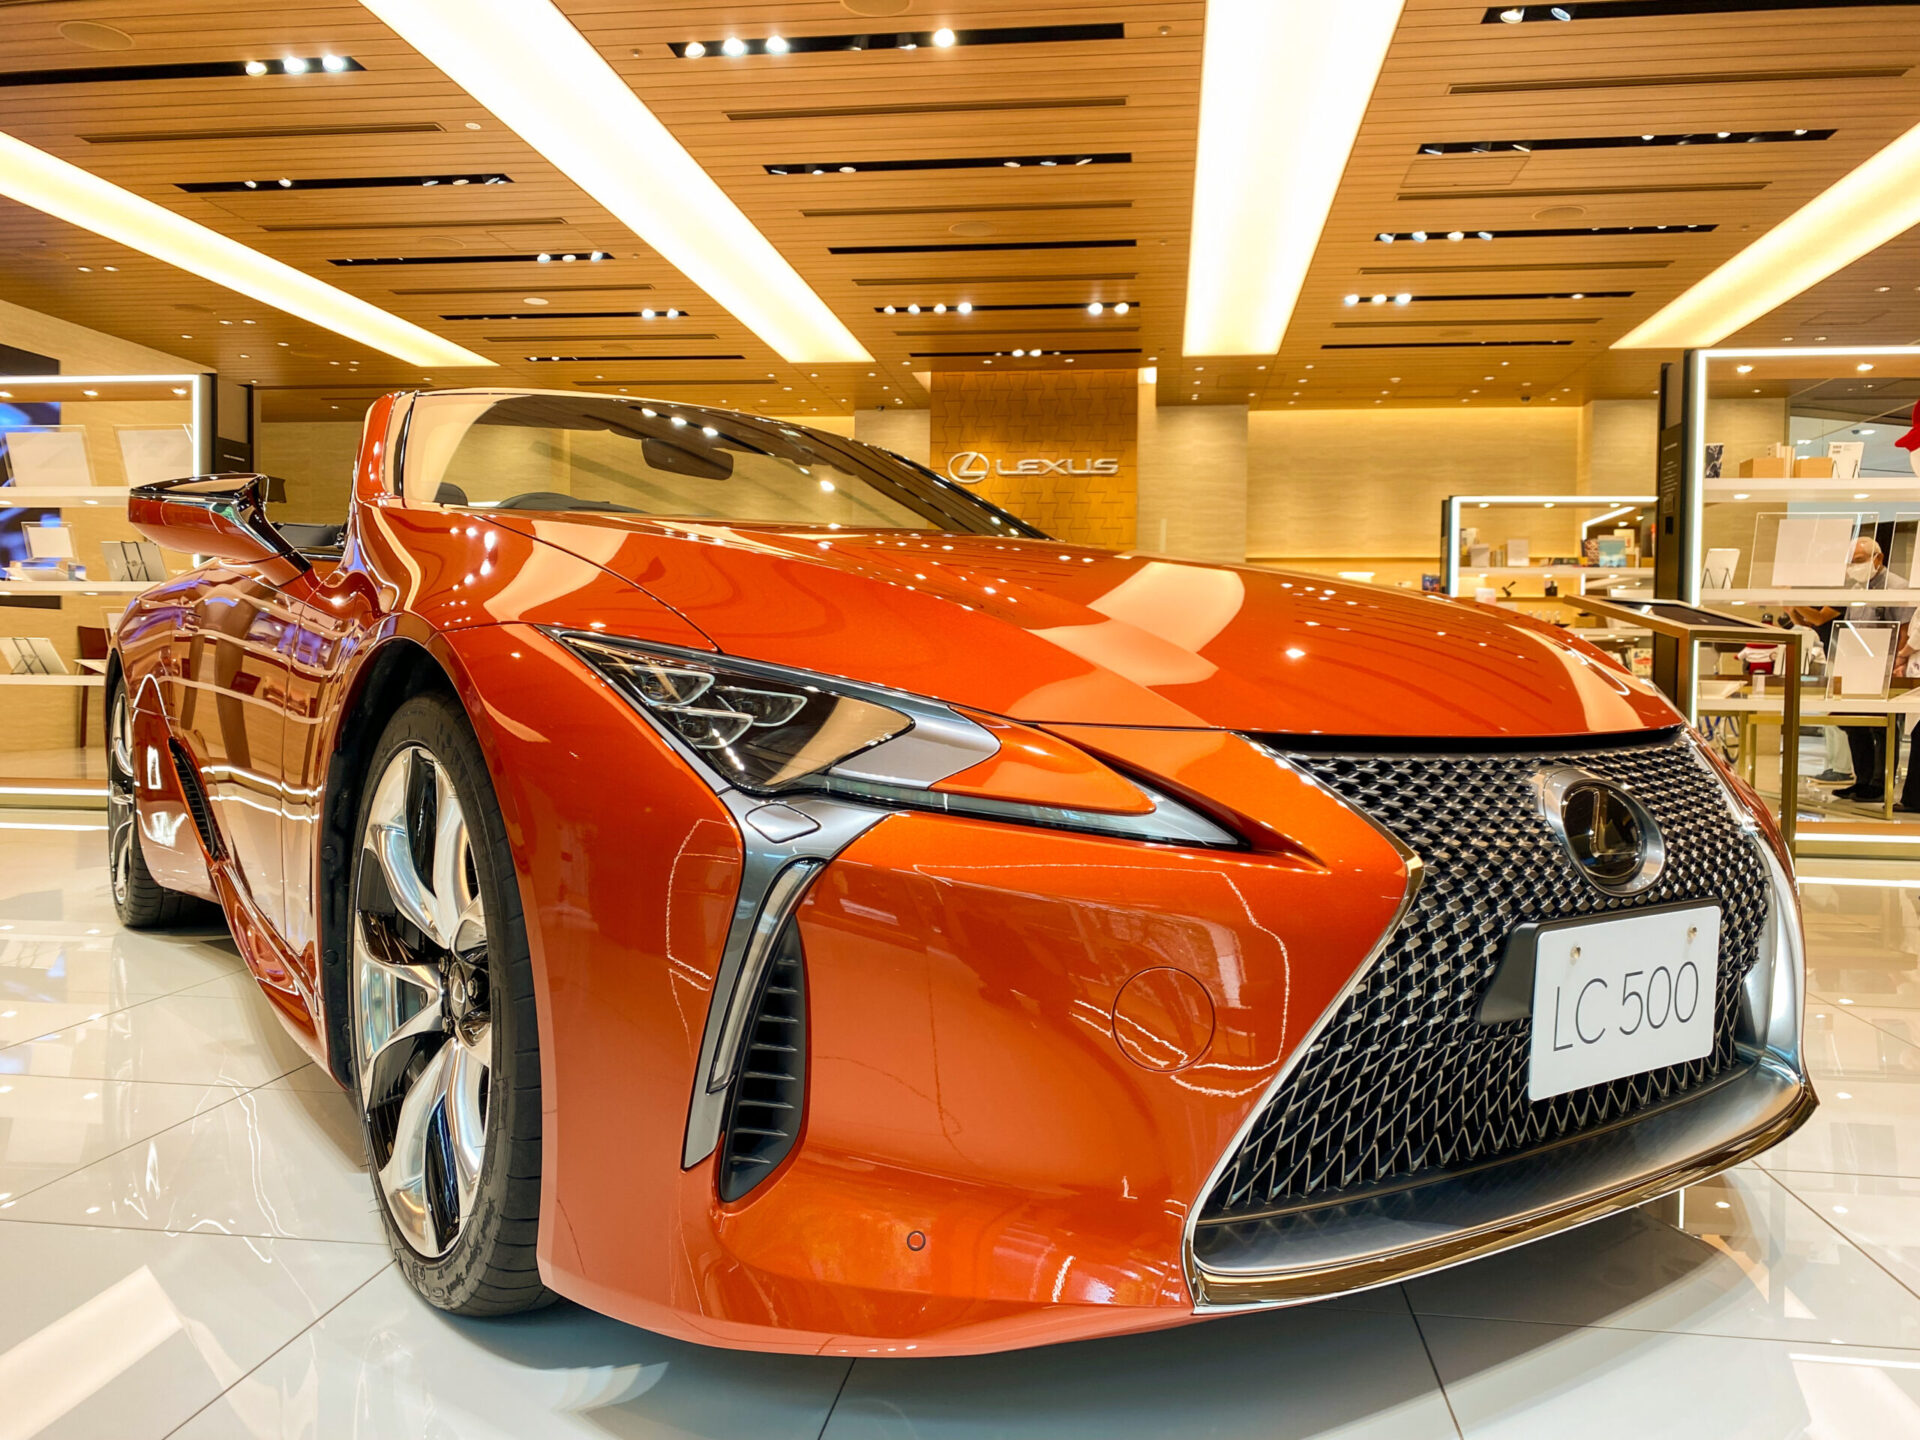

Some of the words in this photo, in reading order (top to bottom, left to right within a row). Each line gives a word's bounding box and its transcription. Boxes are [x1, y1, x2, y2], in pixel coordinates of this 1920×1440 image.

[995, 458, 1119, 476] LEXUS
[1553, 977, 1608, 1052] LC
[1619, 961, 1699, 1035] 500
